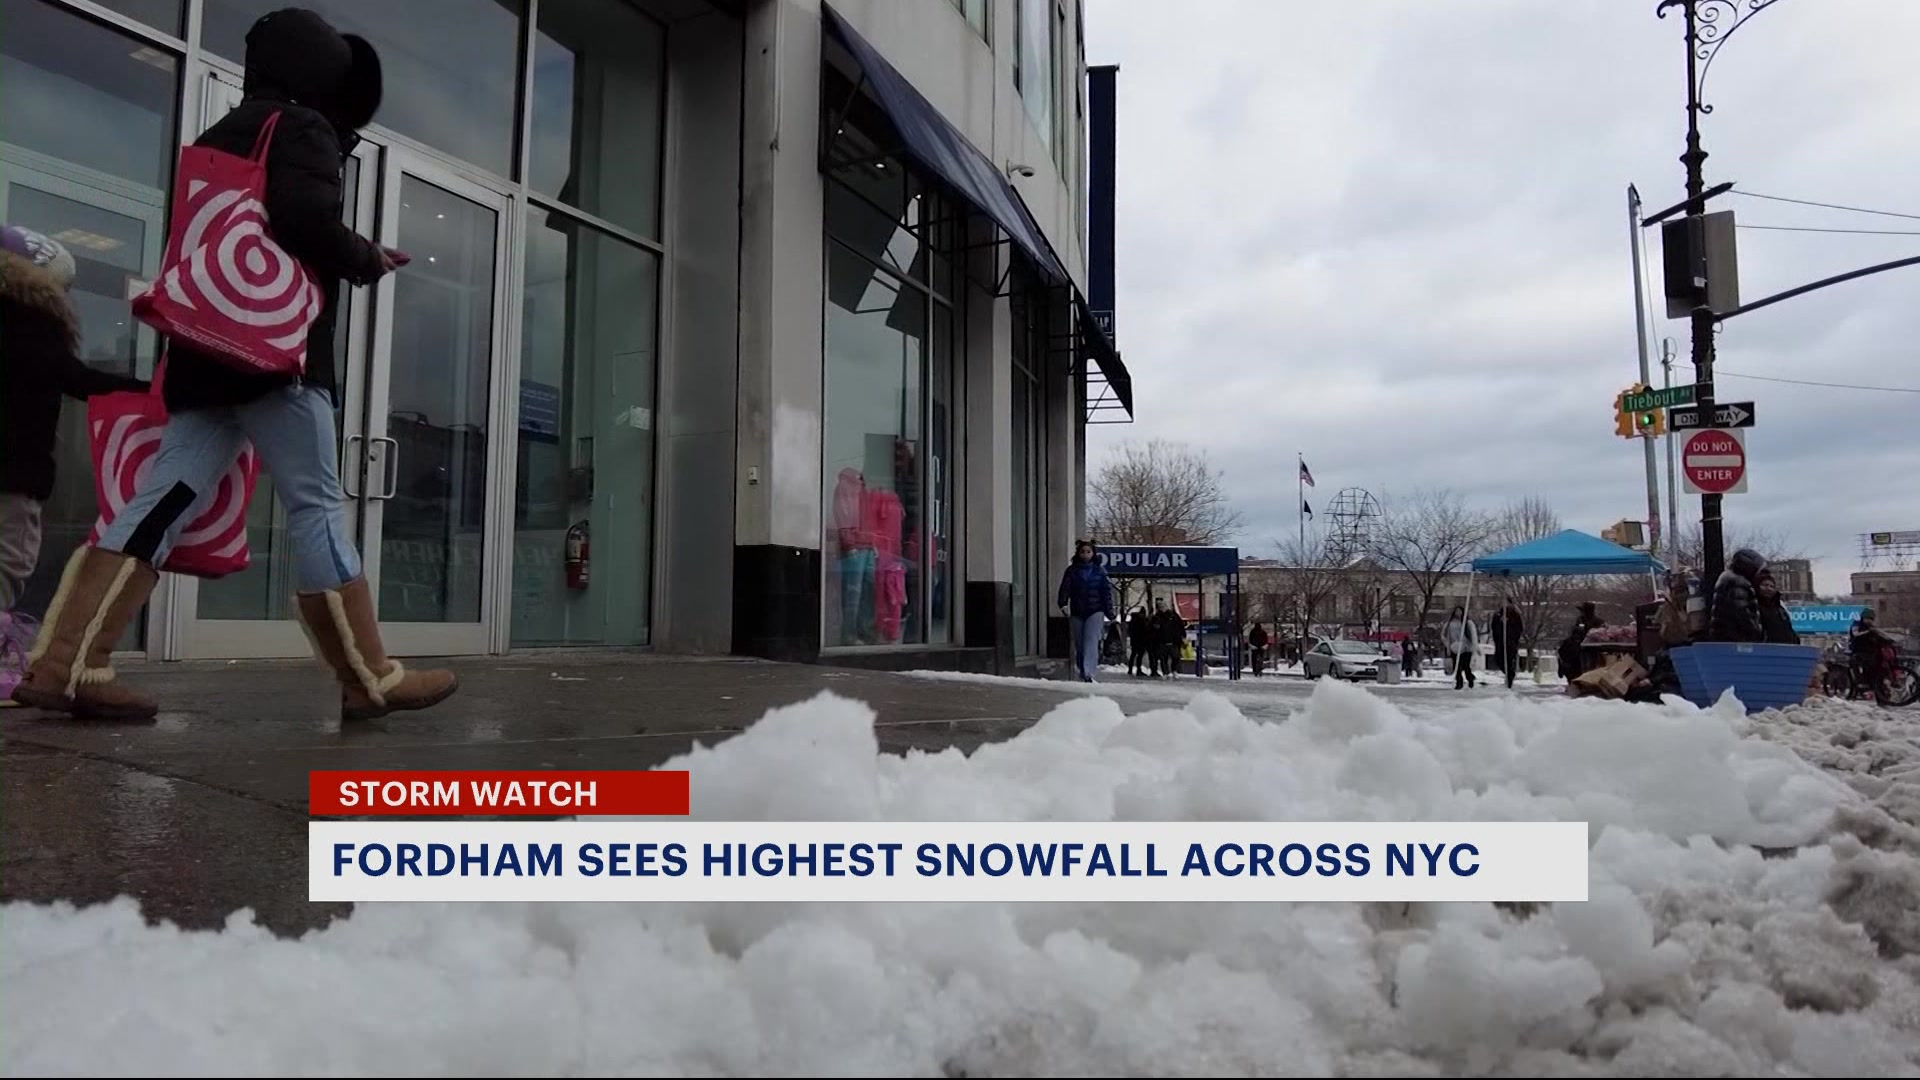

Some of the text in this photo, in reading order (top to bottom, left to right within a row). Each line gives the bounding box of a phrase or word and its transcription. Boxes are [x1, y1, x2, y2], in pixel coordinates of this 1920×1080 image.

[1627, 391, 1676, 410] Tiebout
[1681, 410, 1741, 424] ON WAY
[1692, 442, 1733, 452] DO NOT
[1697, 470, 1733, 480] ENTER
[1095, 552, 1188, 567] OPULAR
[1809, 611, 1838, 621] PAIN
